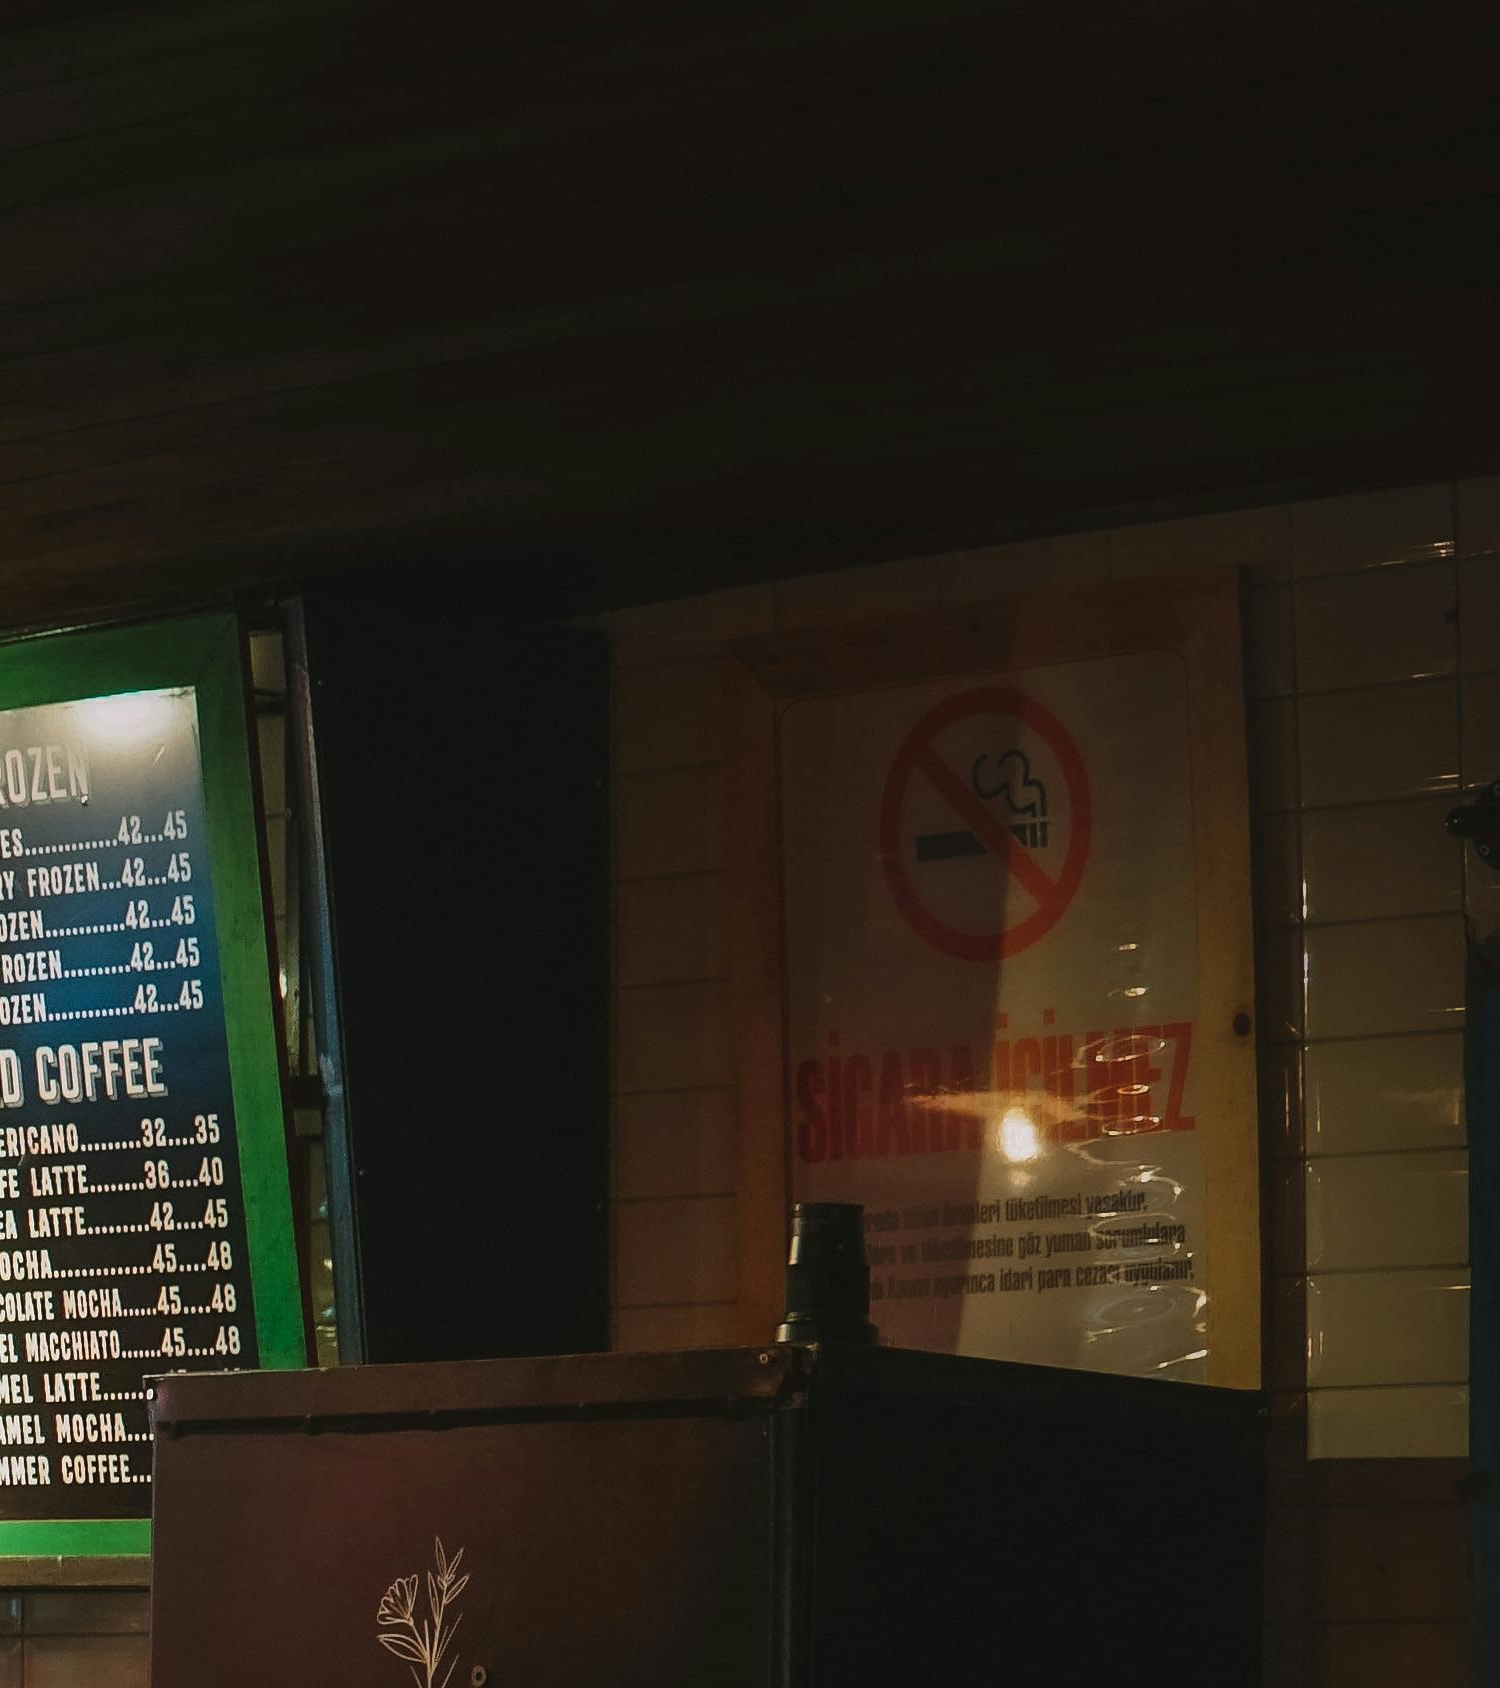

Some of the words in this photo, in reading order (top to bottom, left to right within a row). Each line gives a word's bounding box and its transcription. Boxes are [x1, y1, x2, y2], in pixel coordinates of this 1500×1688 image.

[118, 816, 142, 847] 42
[164, 810, 188, 841] 45
[27, 862, 99, 898] FROZEN
[121, 858, 145, 888] 42
[167, 853, 191, 884] 45
[125, 900, 149, 931] 42
[171, 896, 195, 926] 45
[130, 942, 154, 973] 42
[176, 938, 200, 968] 45
[134, 984, 158, 1015] 42
[179, 980, 203, 1011] 45
[36, 1037, 168, 1103] COFFEE
[141, 1118, 166, 1147] 32
[195, 1114, 220, 1144] 35
[31, 1164, 89, 1197] LATTE
[144, 1160, 169, 1189] 36
[197, 1157, 224, 1186] 40
[28, 1207, 87, 1239] LATTE
[149, 1202, 174, 1231] 42
[204, 1199, 228, 1229] 45
[152, 1244, 177, 1273] 45
[207, 1241, 233, 1271] 48
[1019, 1234, 1042, 1260] göz
[1000, 1273, 1033, 1292] idari
[1038, 1269, 1071, 1293] para
[63, 1288, 123, 1319] MOCHA
[157, 1286, 181, 1315] 45
[211, 1284, 237, 1313] 48
[26, 1330, 121, 1362] MACCHIATO
[161, 1328, 186, 1357] 45
[215, 1325, 241, 1355] 48
[44, 1372, 101, 1403] LATTE
[56, 1413, 127, 1443] MOCHA
[61, 1454, 131, 1484] COFFEE
